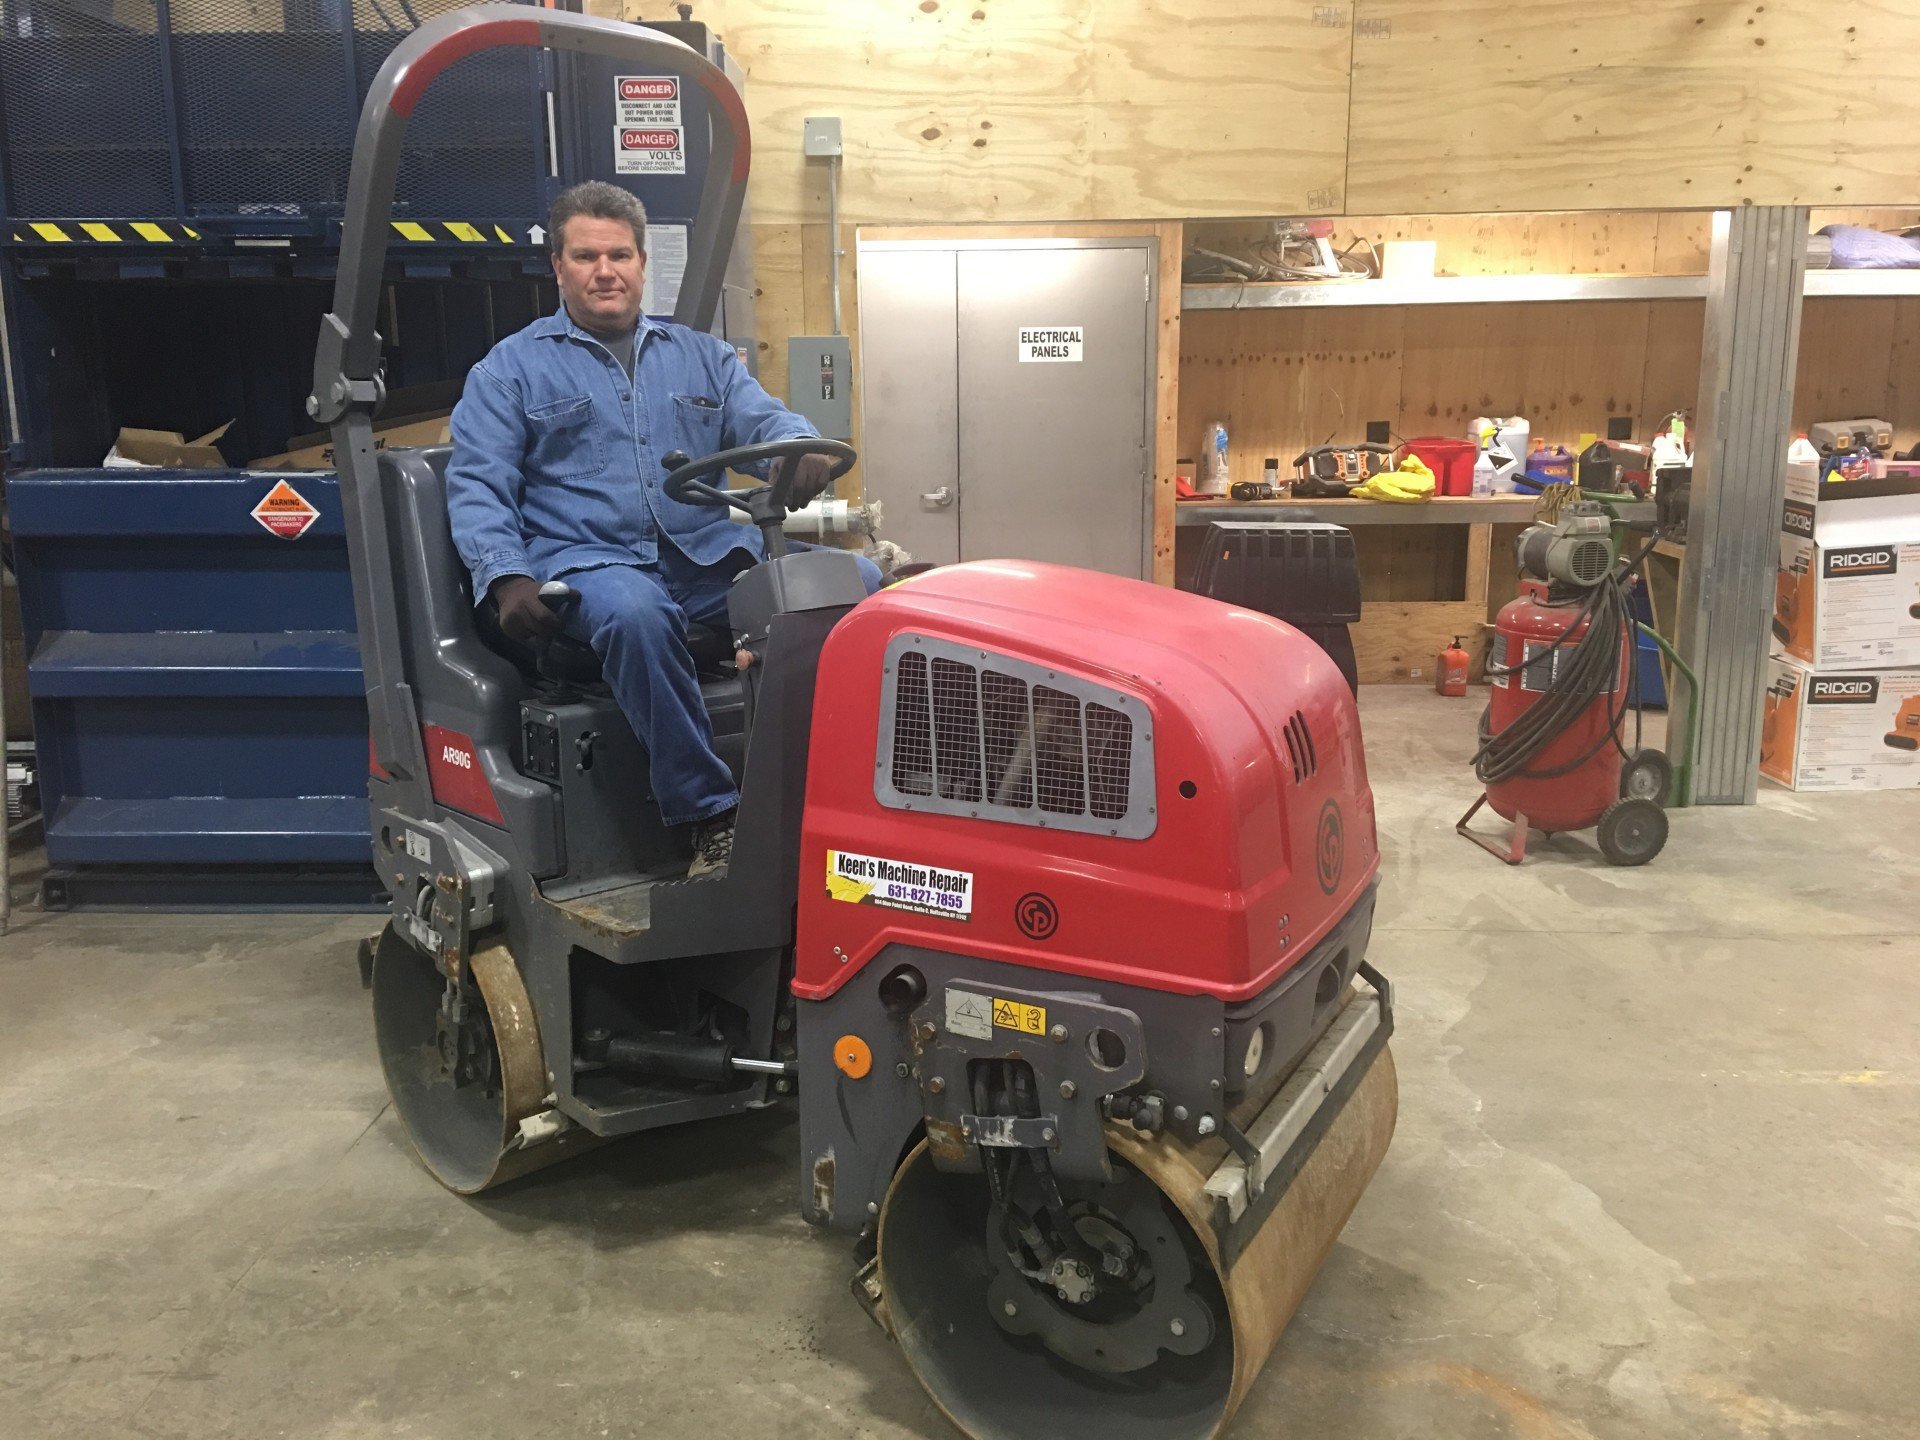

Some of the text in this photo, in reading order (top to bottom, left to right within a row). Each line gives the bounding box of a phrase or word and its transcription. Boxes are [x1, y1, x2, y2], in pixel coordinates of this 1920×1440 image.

[625, 85, 672, 94] DANGER
[625, 134, 674, 144] DANGER
[649, 151, 682, 160] VOLTS
[1021, 331, 1081, 343] ELECTRICAL
[1032, 346, 1069, 357] PANELS
[823, 355, 830, 365] ON
[1784, 512, 1812, 531] RIDGID
[1830, 552, 1890, 567] RIDGID
[1815, 681, 1872, 694] RIDGID
[443, 745, 471, 770] AR90G
[838, 854, 969, 894] Keen's Machine Repair
[888, 883, 963, 909] 631-827-7855
